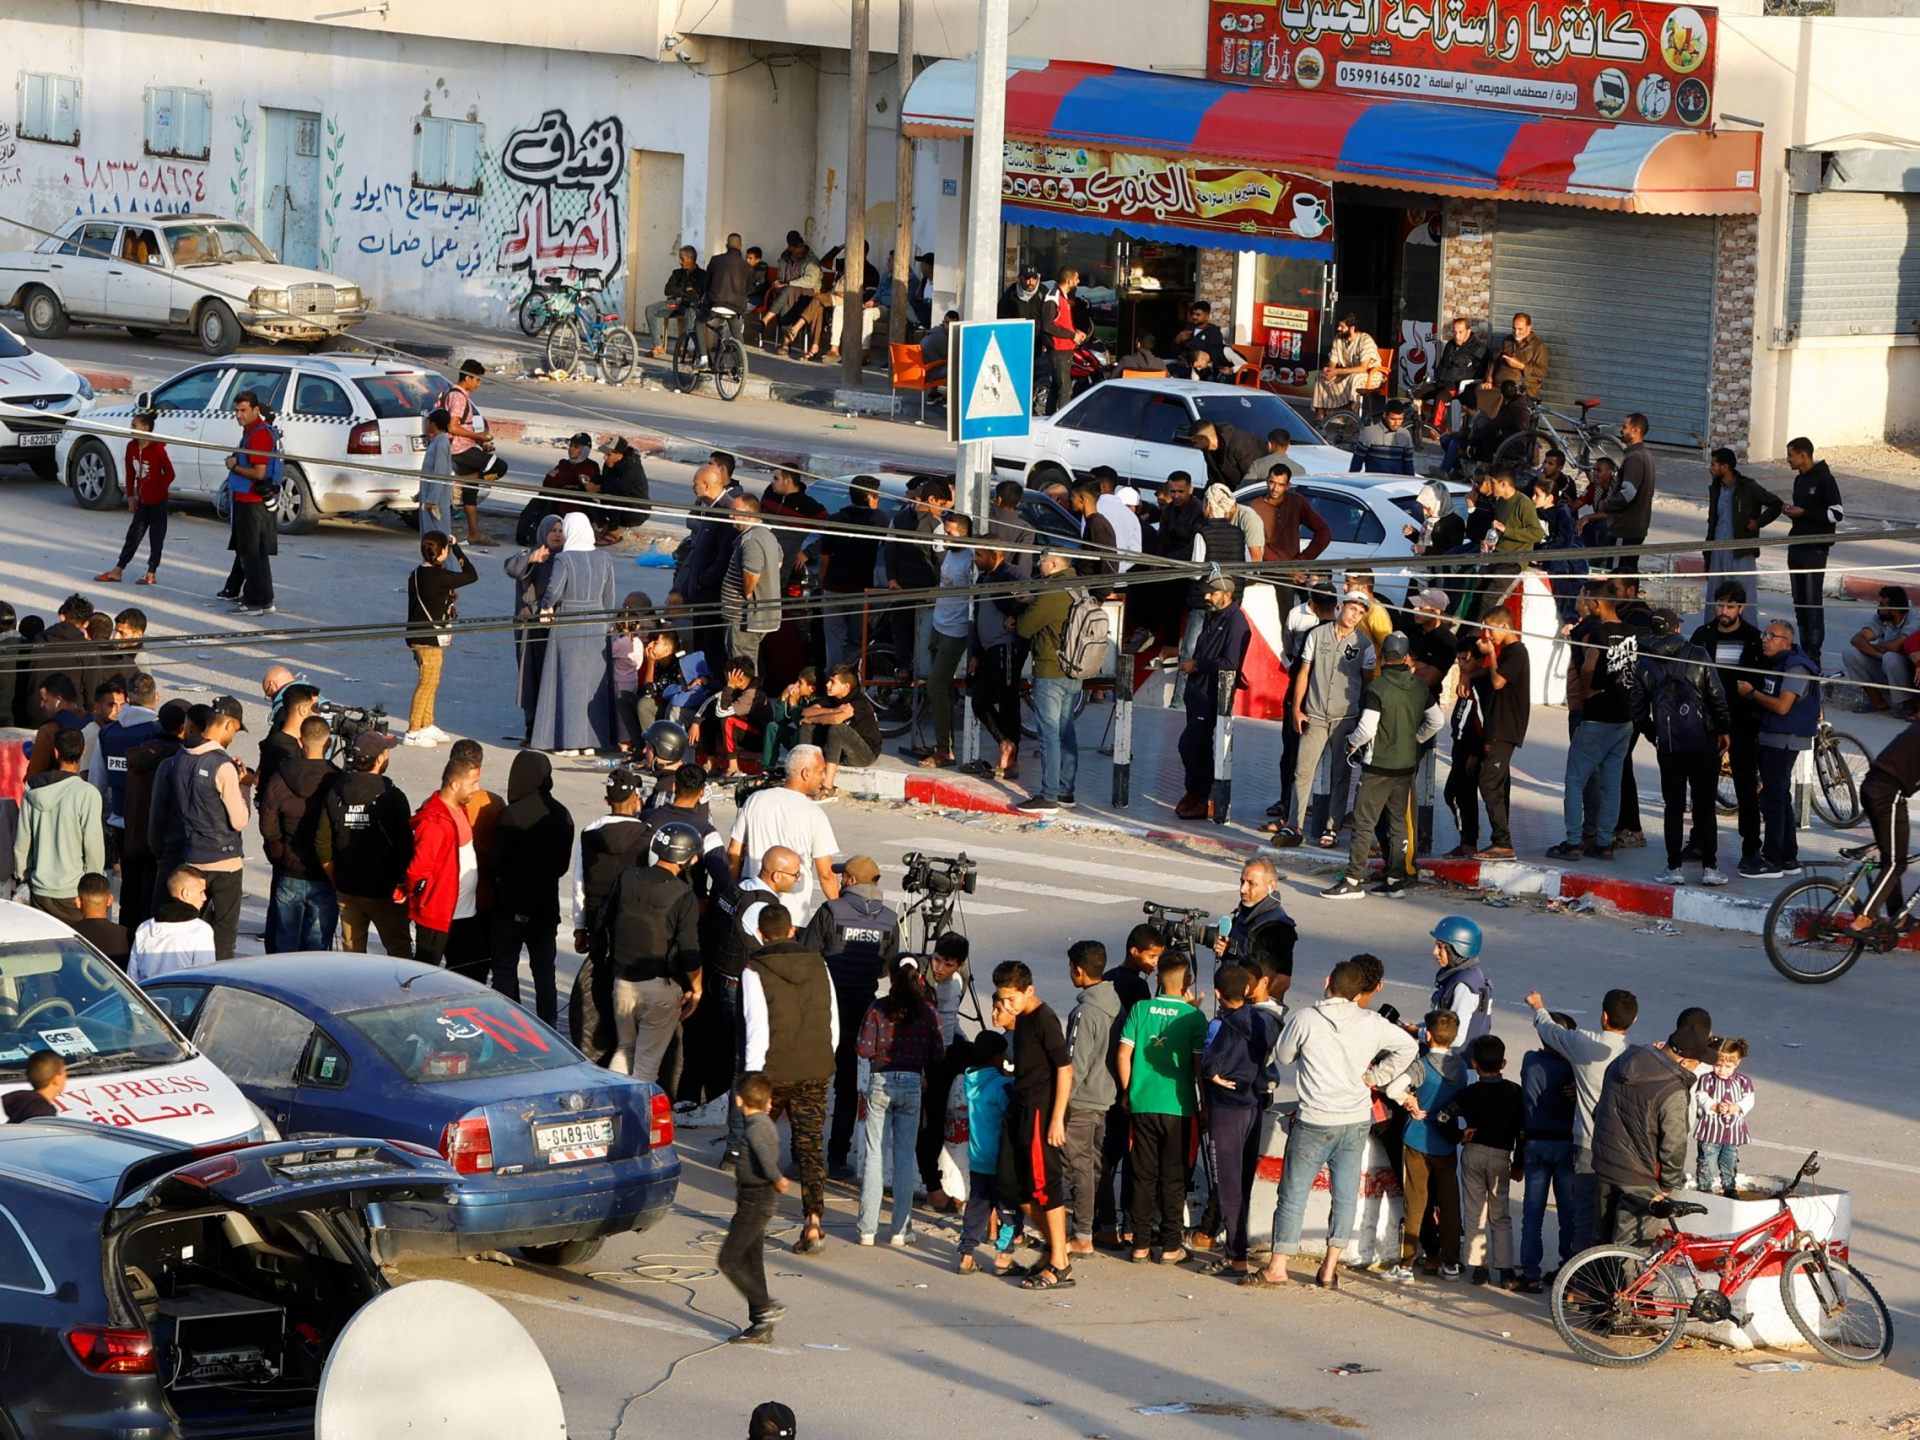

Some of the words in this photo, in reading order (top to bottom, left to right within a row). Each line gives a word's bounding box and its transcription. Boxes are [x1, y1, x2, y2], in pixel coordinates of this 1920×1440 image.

[1499, 17, 1520, 61] و
[1340, 66, 1421, 89] 0599164502
[1513, 86, 1548, 99] مصطفى
[502, 109, 624, 189] فندق
[405, 188, 439, 220] شارع
[1085, 162, 1197, 220] الجنوب
[108, 758, 128, 770] PRE
[845, 927, 880, 943] PRESS
[1149, 1006, 1178, 1016] SAUDI
[442, 1007, 553, 1053] TV
[52, 1088, 94, 1114] TV
[96, 1075, 210, 1102] PRESS
